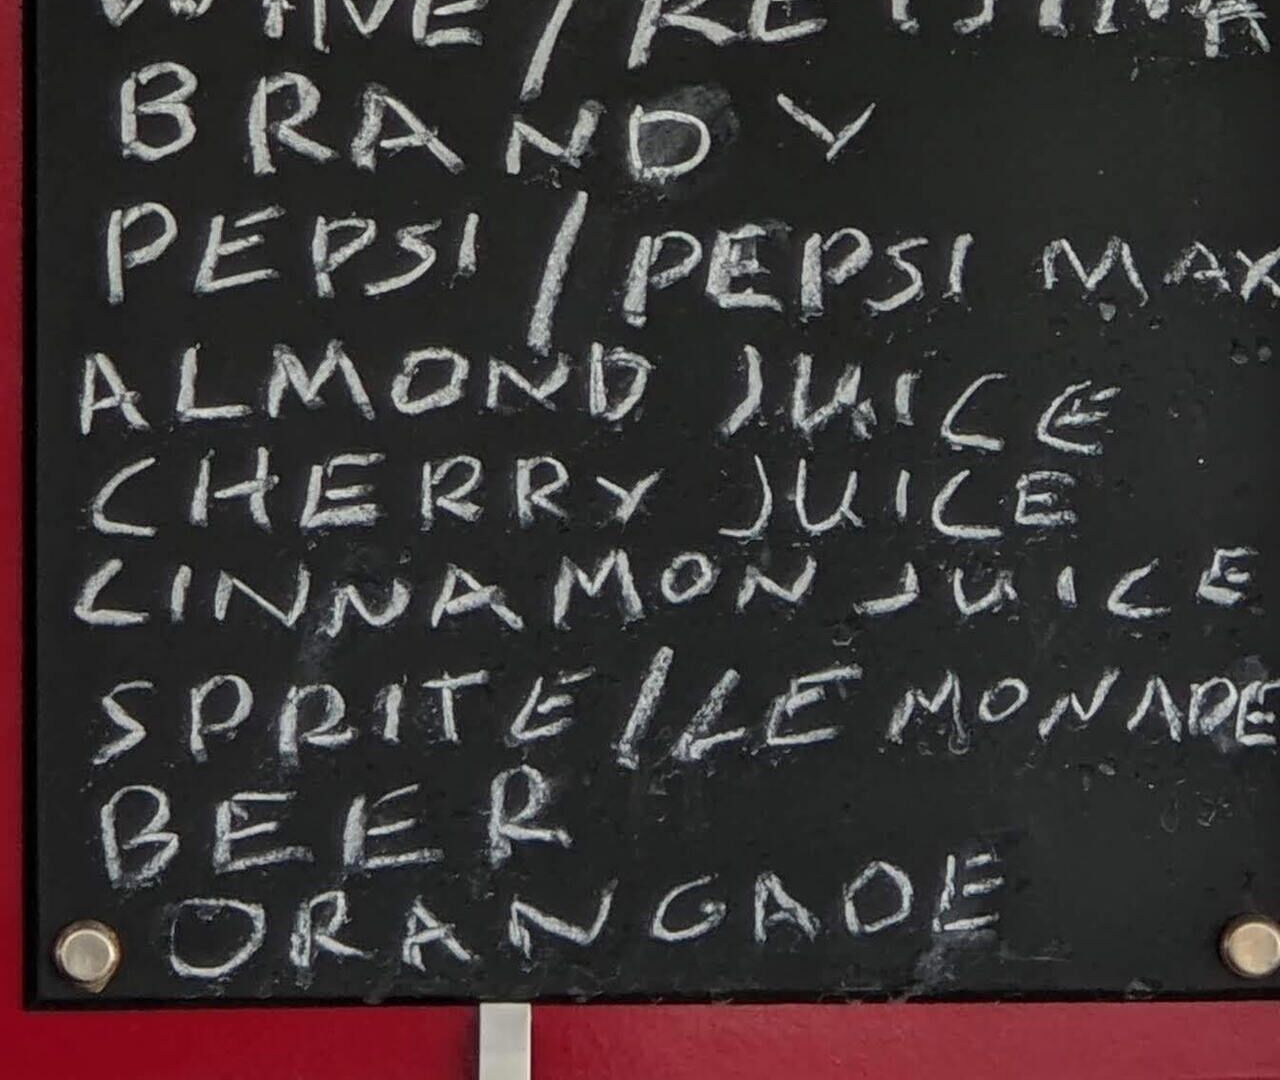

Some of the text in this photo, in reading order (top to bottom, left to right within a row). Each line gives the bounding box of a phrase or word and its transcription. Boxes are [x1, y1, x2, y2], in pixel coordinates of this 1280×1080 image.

[121, 62, 875, 178] BRANDY
[80, 342, 1118, 455] ALMOND JUICE
[92, 447, 1082, 539] CHERRY JUICE
[74, 546, 1260, 637] CINNAMON JUICE
[101, 766, 570, 886] BEER
